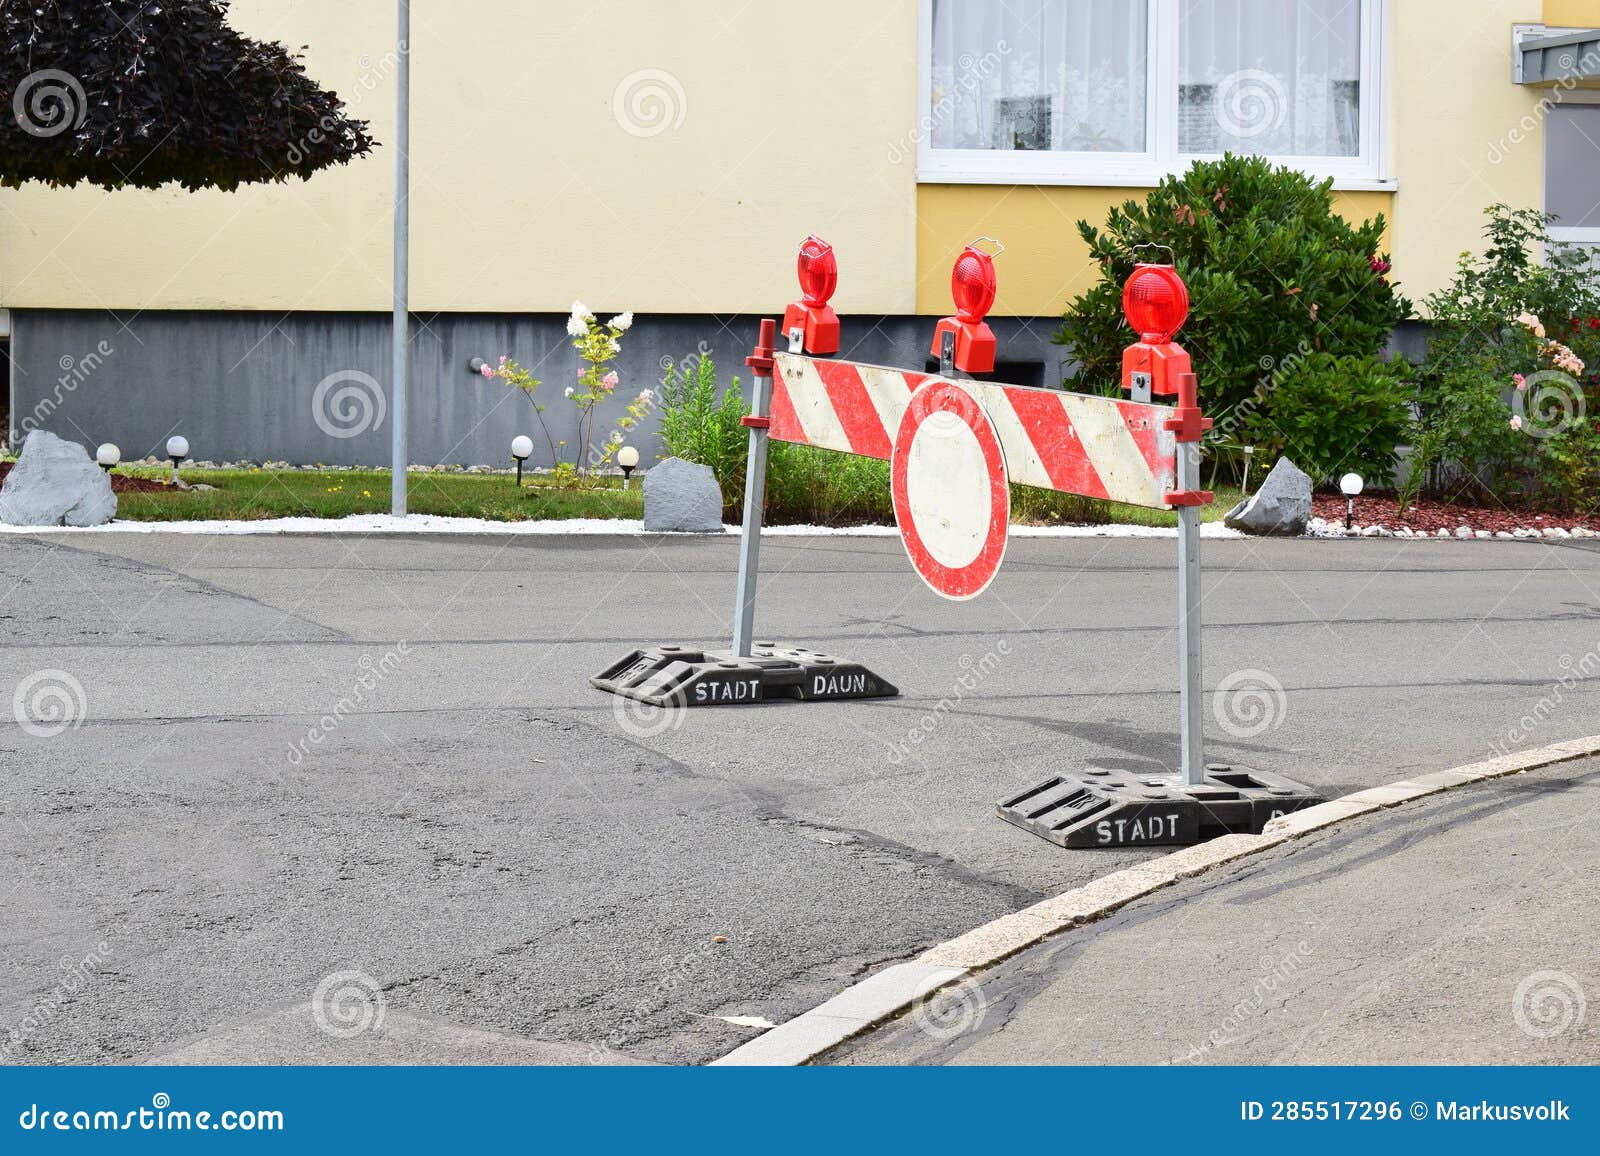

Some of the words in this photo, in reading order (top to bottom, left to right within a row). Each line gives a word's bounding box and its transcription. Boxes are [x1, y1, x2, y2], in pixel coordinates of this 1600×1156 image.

[695, 680, 759, 700] STADT
[813, 674, 865, 694] DAUN
[1096, 814, 1180, 843] STADT
